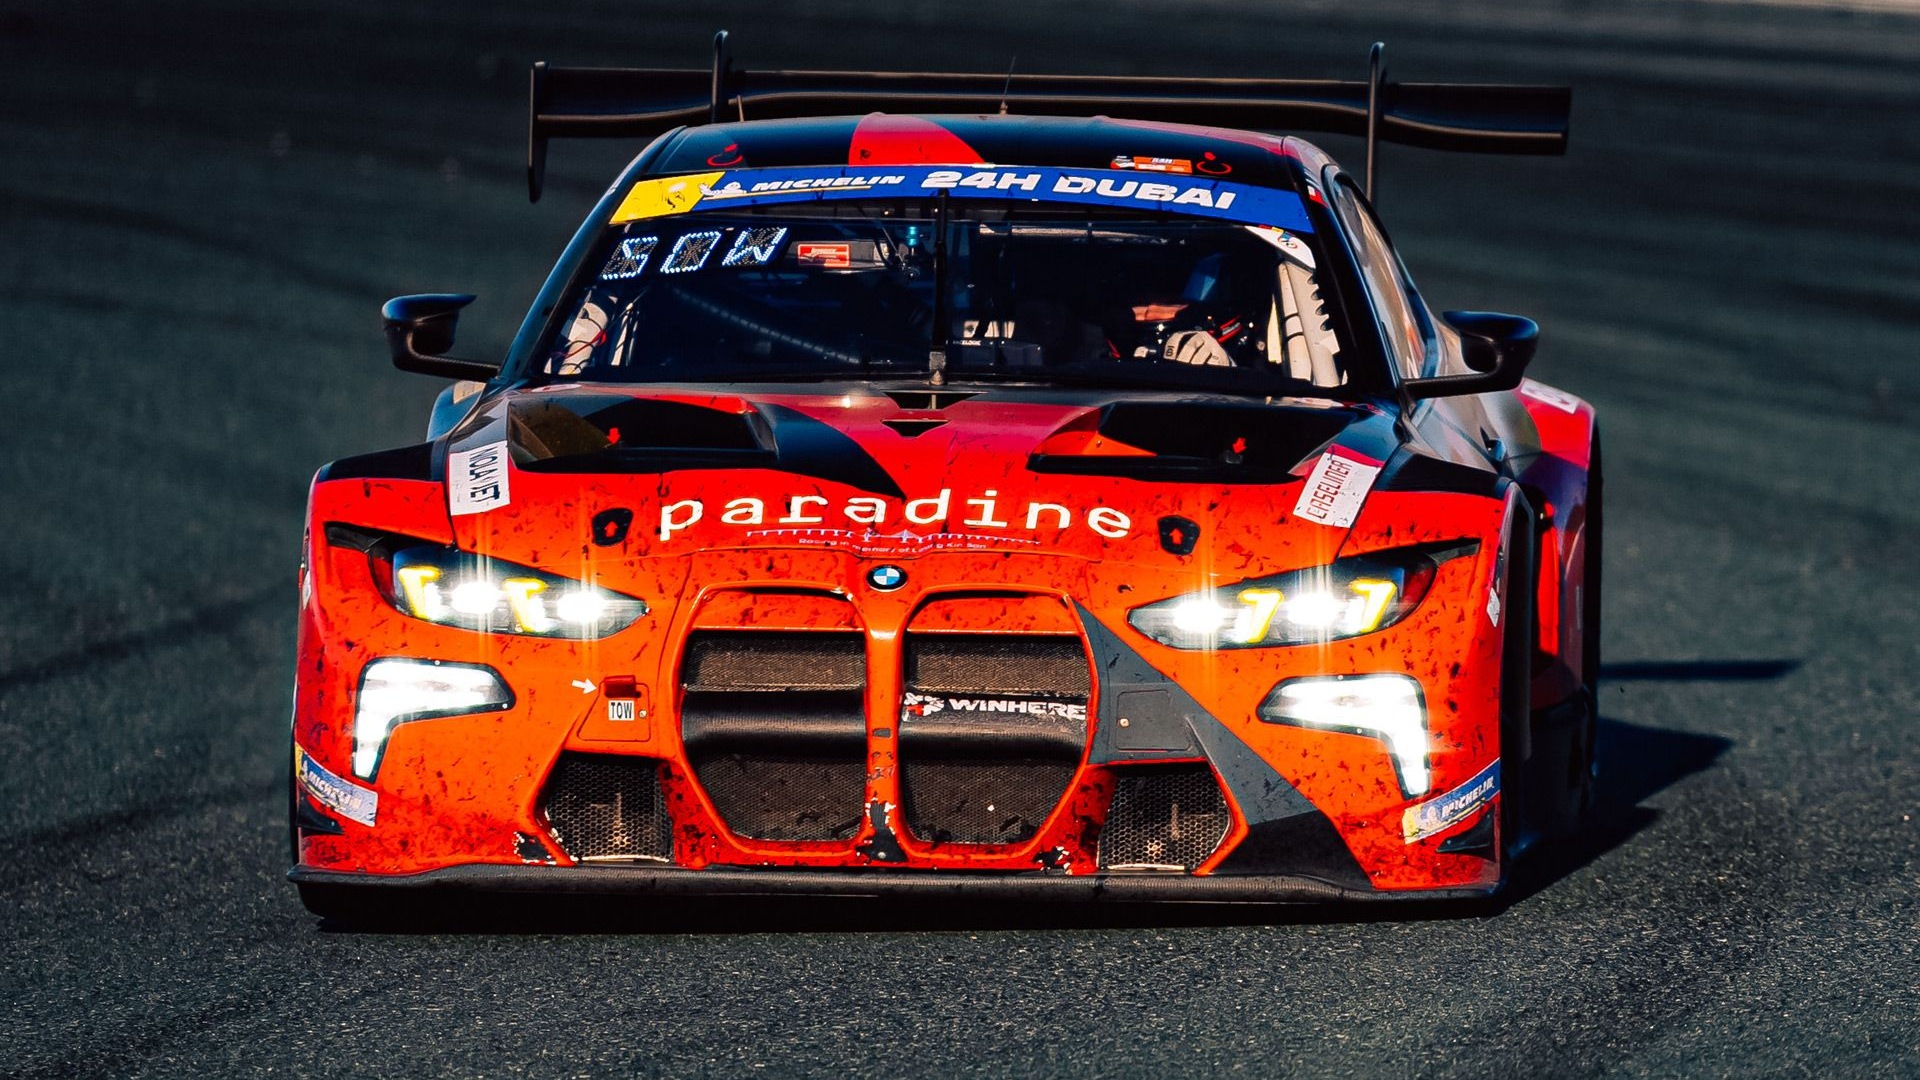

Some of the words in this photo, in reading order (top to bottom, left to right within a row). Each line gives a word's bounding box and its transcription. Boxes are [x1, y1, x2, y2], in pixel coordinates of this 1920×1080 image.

[751, 175, 906, 192] MICHELIN
[921, 171, 1041, 190] 24H
[1052, 176, 1237, 209] DUBAI
[1306, 459, 1352, 520] CASELINER
[659, 488, 1132, 542] paradine
[611, 702, 633, 719] TOW
[948, 698, 1087, 722] WINHERE
